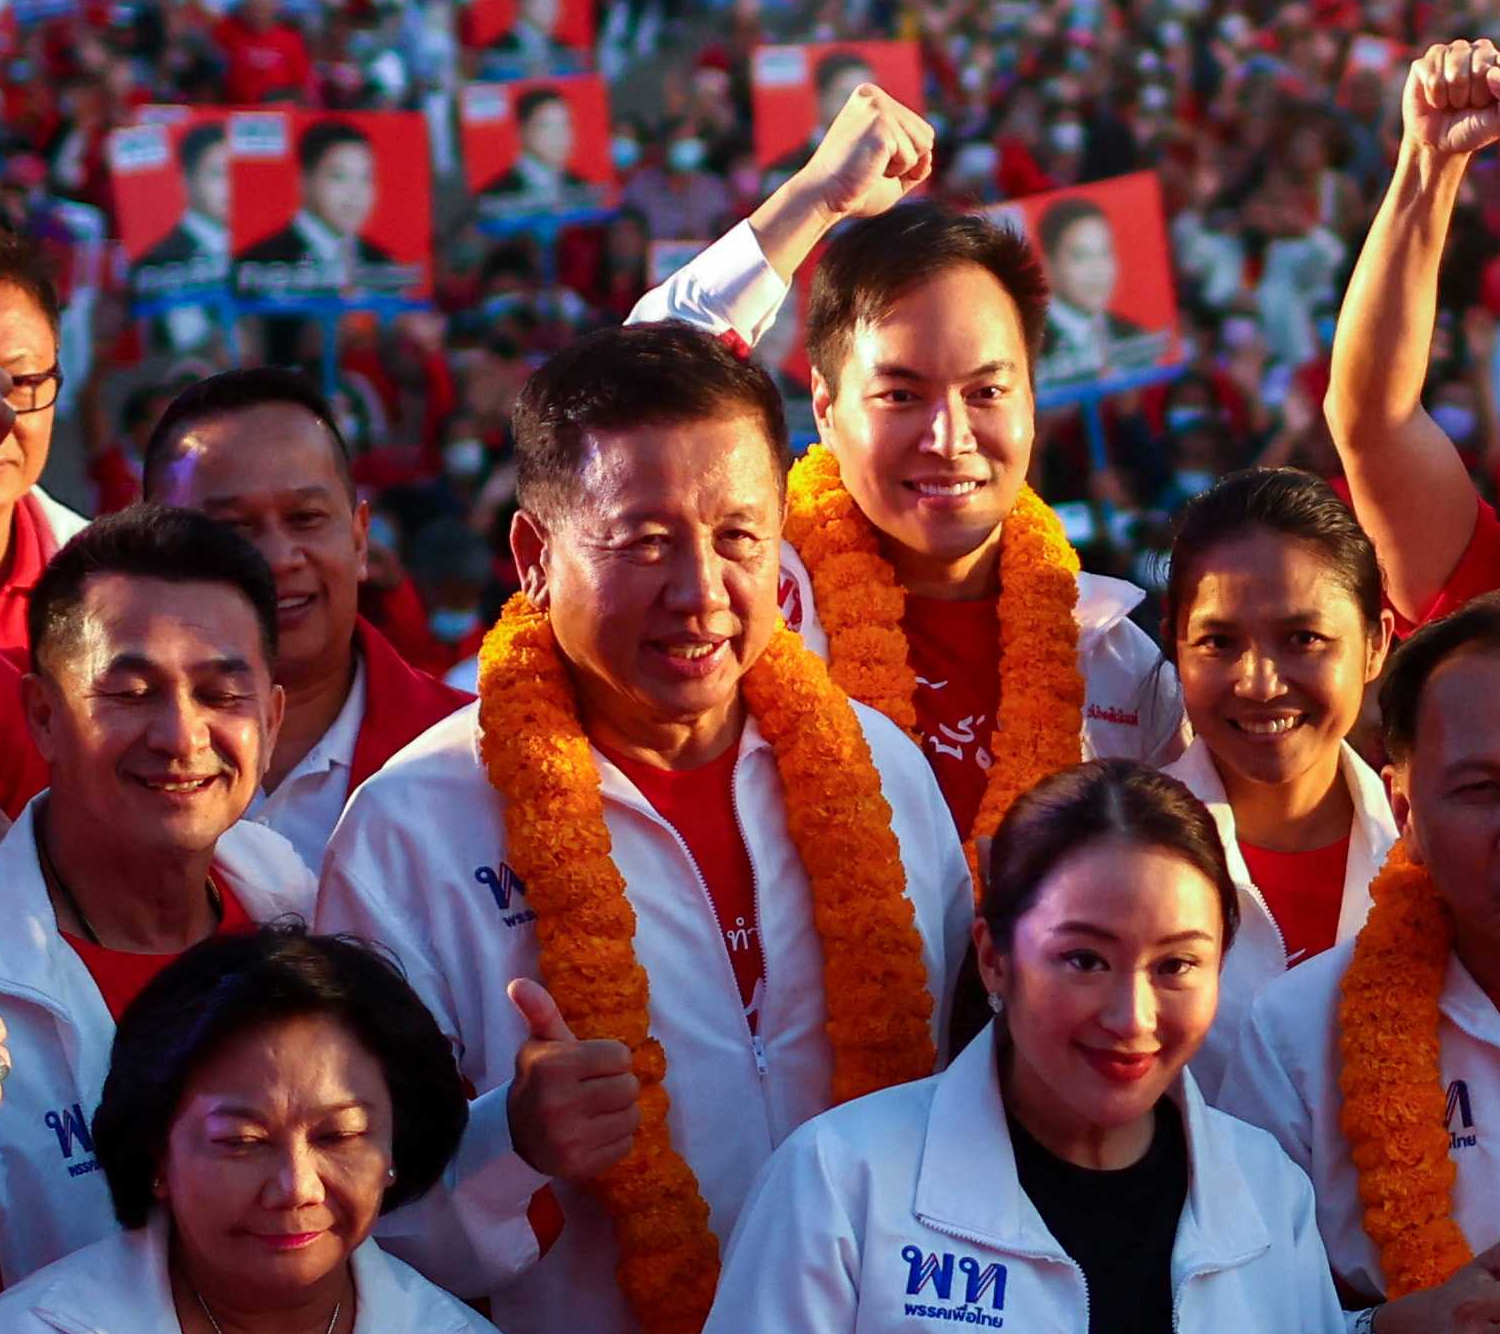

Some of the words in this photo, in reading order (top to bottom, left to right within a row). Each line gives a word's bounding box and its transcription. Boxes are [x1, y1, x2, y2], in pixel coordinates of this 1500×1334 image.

[901, 1245, 1008, 1311] พท
[904, 1303, 1004, 1328] พรรคเพื่อไทย
